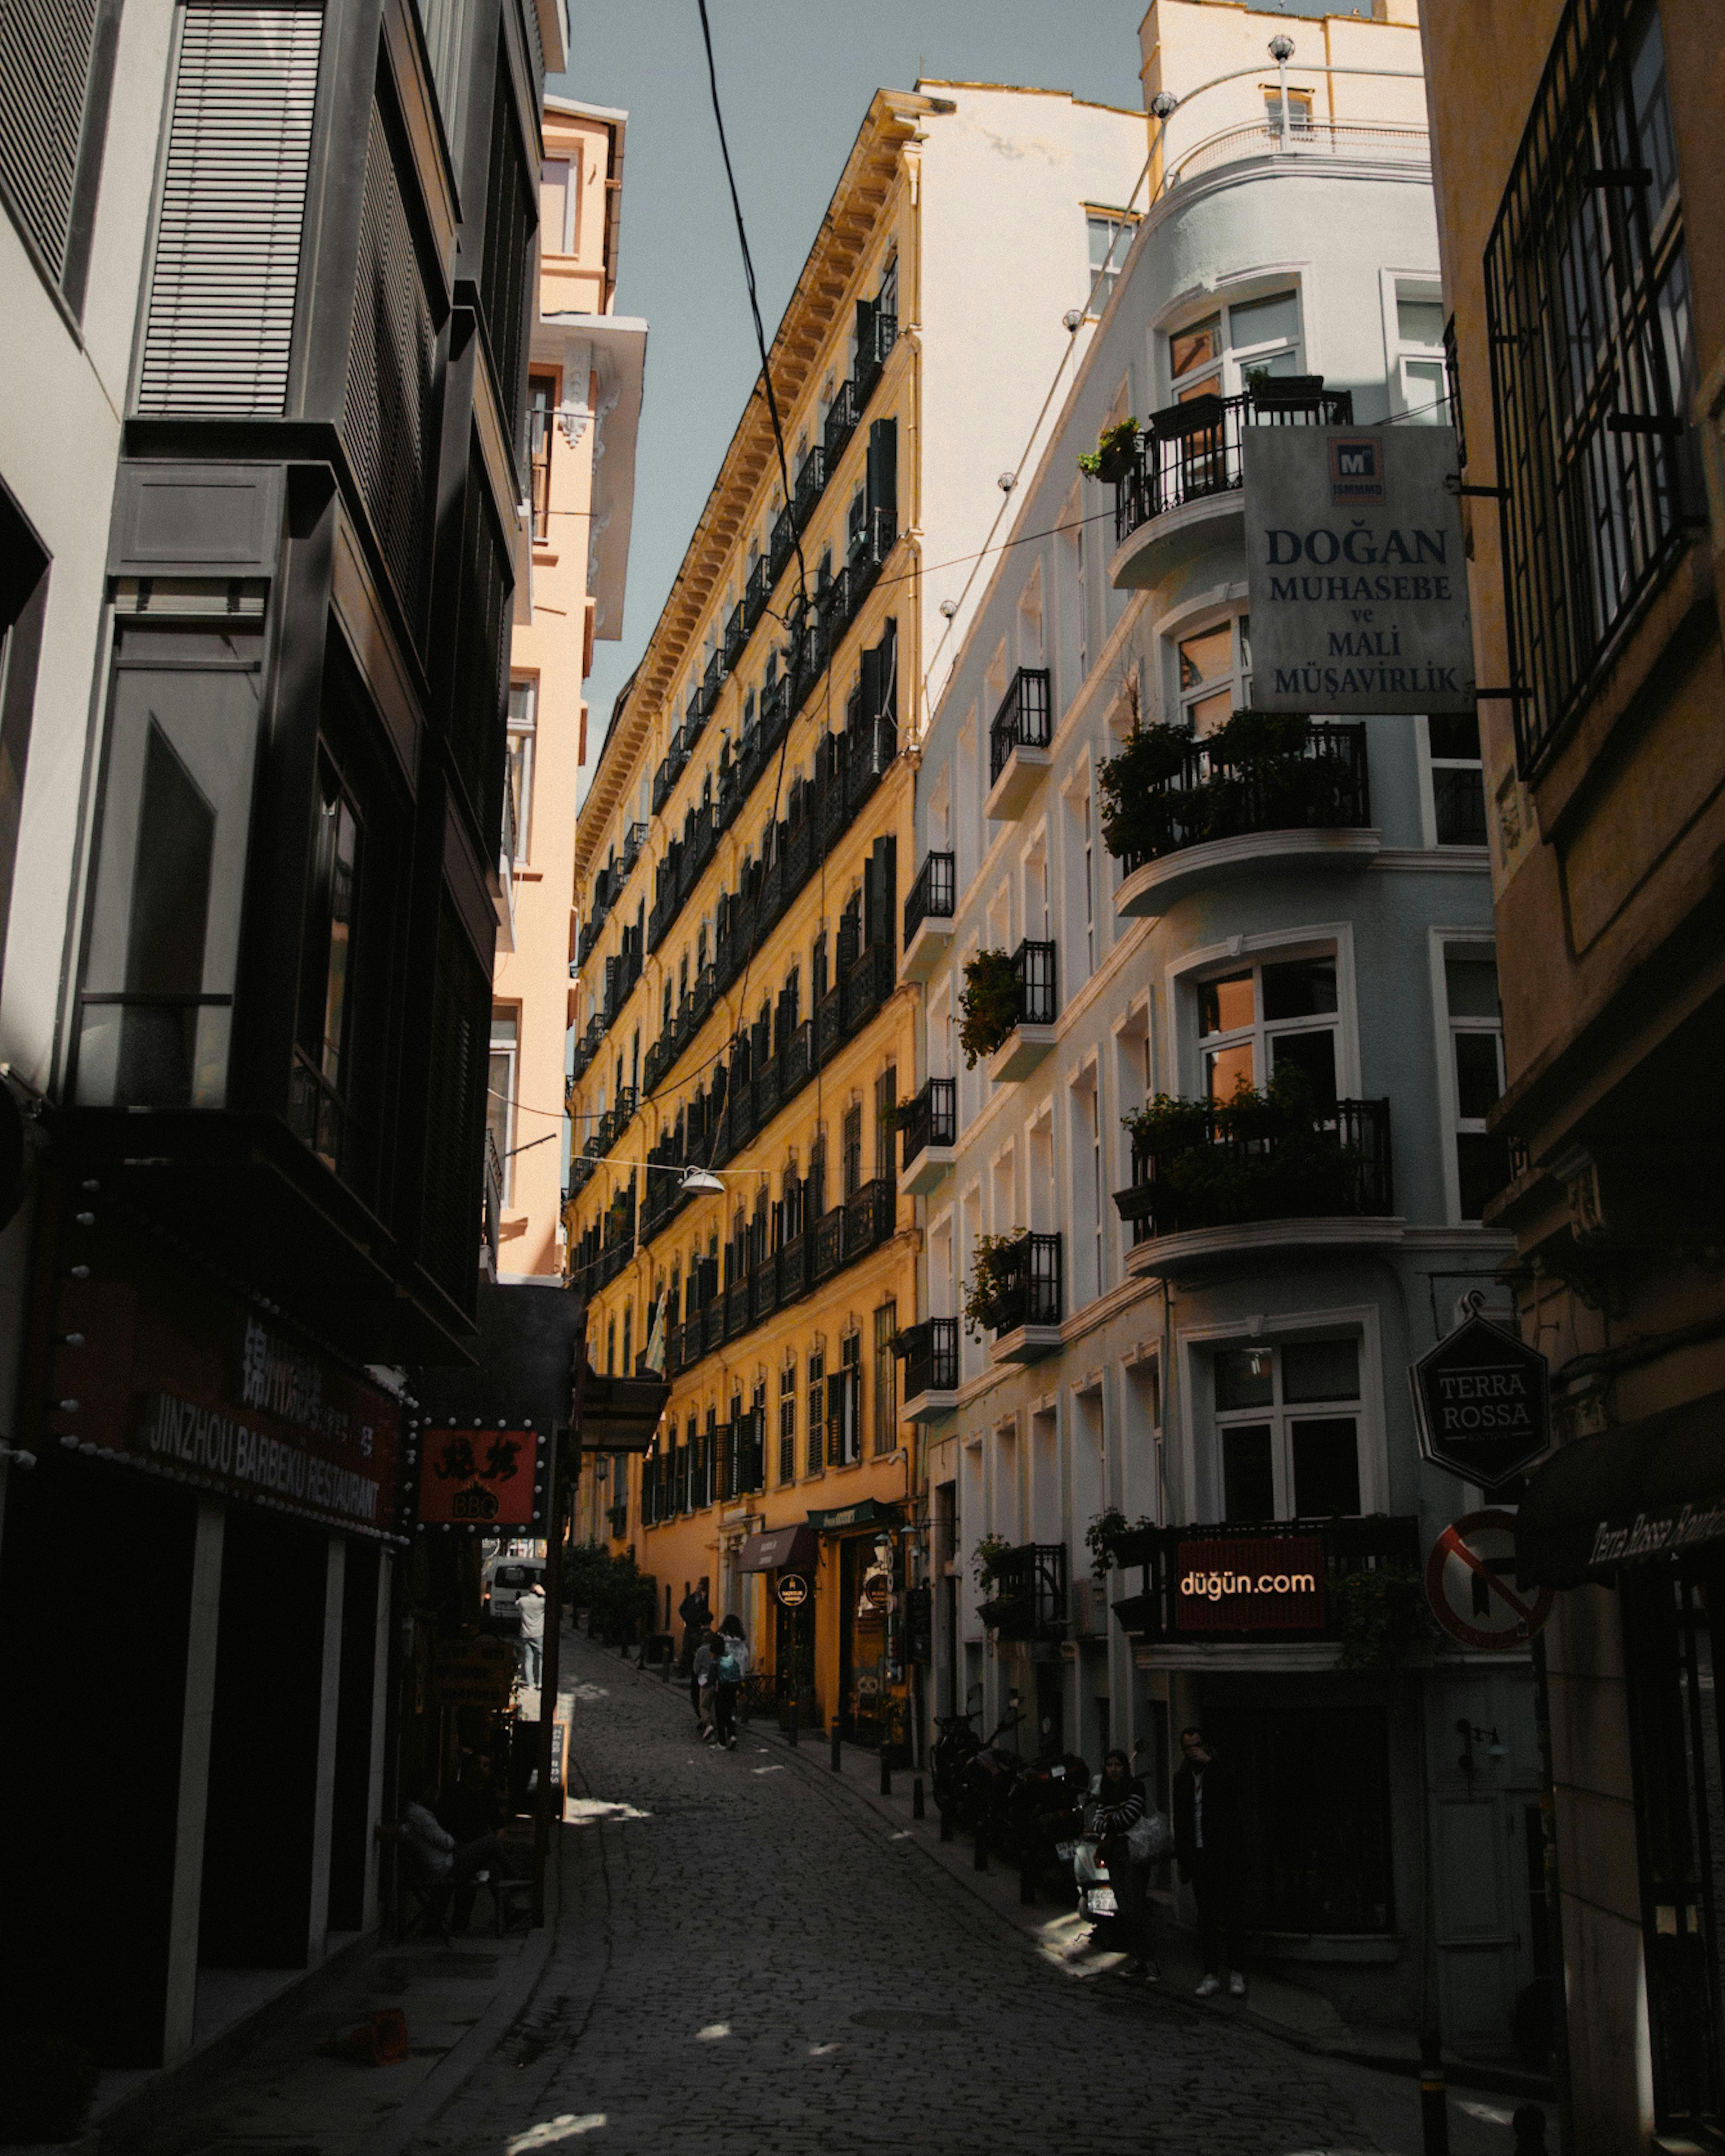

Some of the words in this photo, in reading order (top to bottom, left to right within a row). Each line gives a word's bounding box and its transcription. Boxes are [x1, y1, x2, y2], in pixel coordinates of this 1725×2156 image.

[1265, 520, 1447, 565] DOĞAN
[1270, 576, 1452, 601] MUHASEBE
[1351, 609, 1373, 622] ve
[1328, 625, 1401, 656] MALİ
[1274, 661, 1459, 700] MÜŞAVİRLİK
[1440, 1373, 1527, 1399] TERRA
[1442, 1403, 1531, 1429] ROSSA
[150, 1392, 234, 1473] JINZHOU
[235, 1426, 306, 1498] BARBEKU
[307, 1456, 379, 1520] RESTAURANT
[454, 1495, 496, 1518] BBQ
[1588, 1521, 1628, 1564] Terra
[1622, 1514, 1672, 1557] Rossa
[1180, 1570, 1316, 1601] düğün.com
